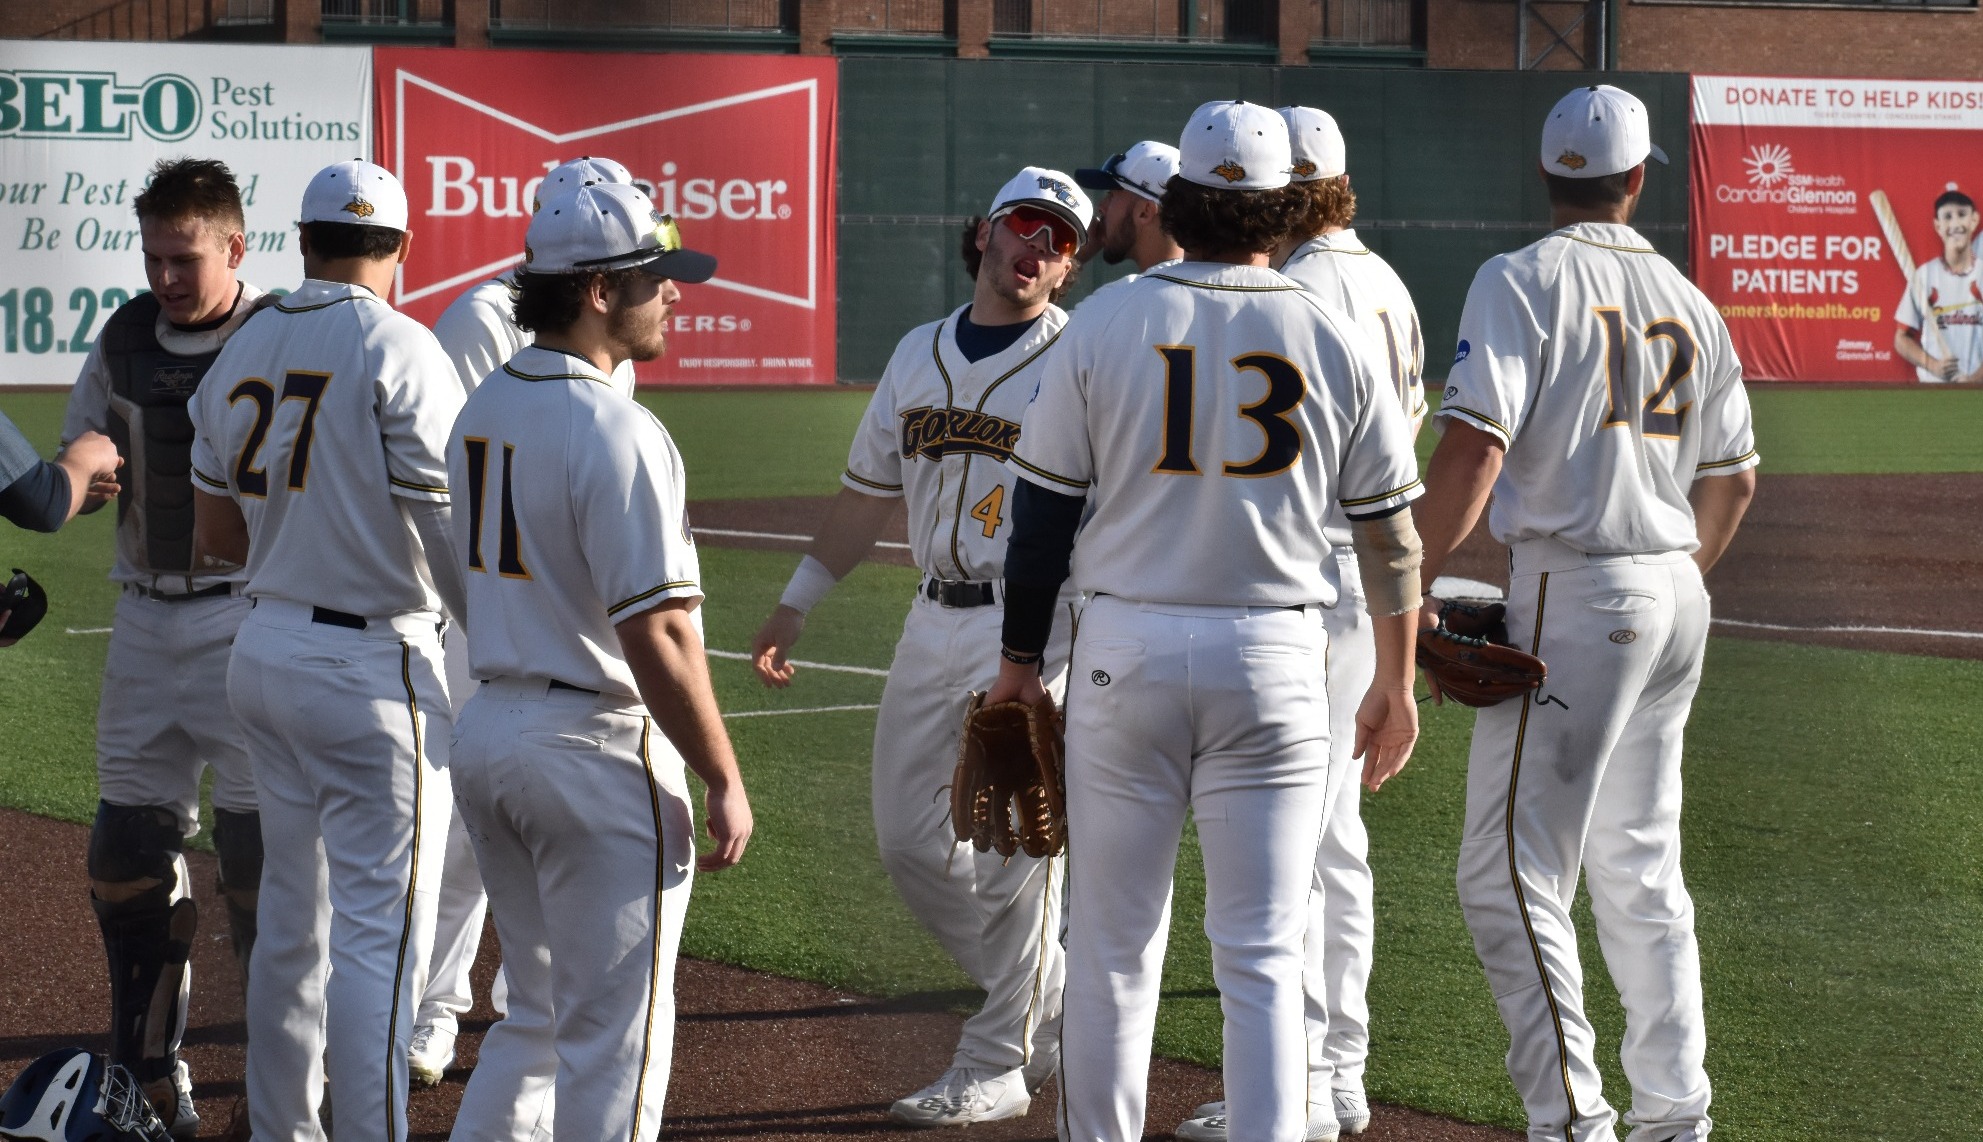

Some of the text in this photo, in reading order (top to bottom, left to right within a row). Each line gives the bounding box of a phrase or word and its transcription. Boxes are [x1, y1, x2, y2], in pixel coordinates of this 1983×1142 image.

[211, 77, 274, 106] Pest
[1725, 87, 1983, 110] DONATE TO HELP KIDS!
[211, 112, 360, 141] Solutions
[58, 171, 129, 206] Pest
[19, 217, 139, 251] Be Our
[1710, 234, 1881, 260] PLEDGE FOR
[1732, 269, 1859, 294] PATIENTS
[1719, 302, 1881, 322] omersforhealth.org
[679, 358, 701, 368] ENJOY
[762, 358, 786, 368] DRINK
[1591, 306, 1698, 440] 12
[1150, 345, 1308, 478] 13
[227, 370, 334, 499] 27
[900, 405, 1022, 460] GORLOK
[463, 436, 533, 581] 11
[971, 484, 1004, 538] 4
